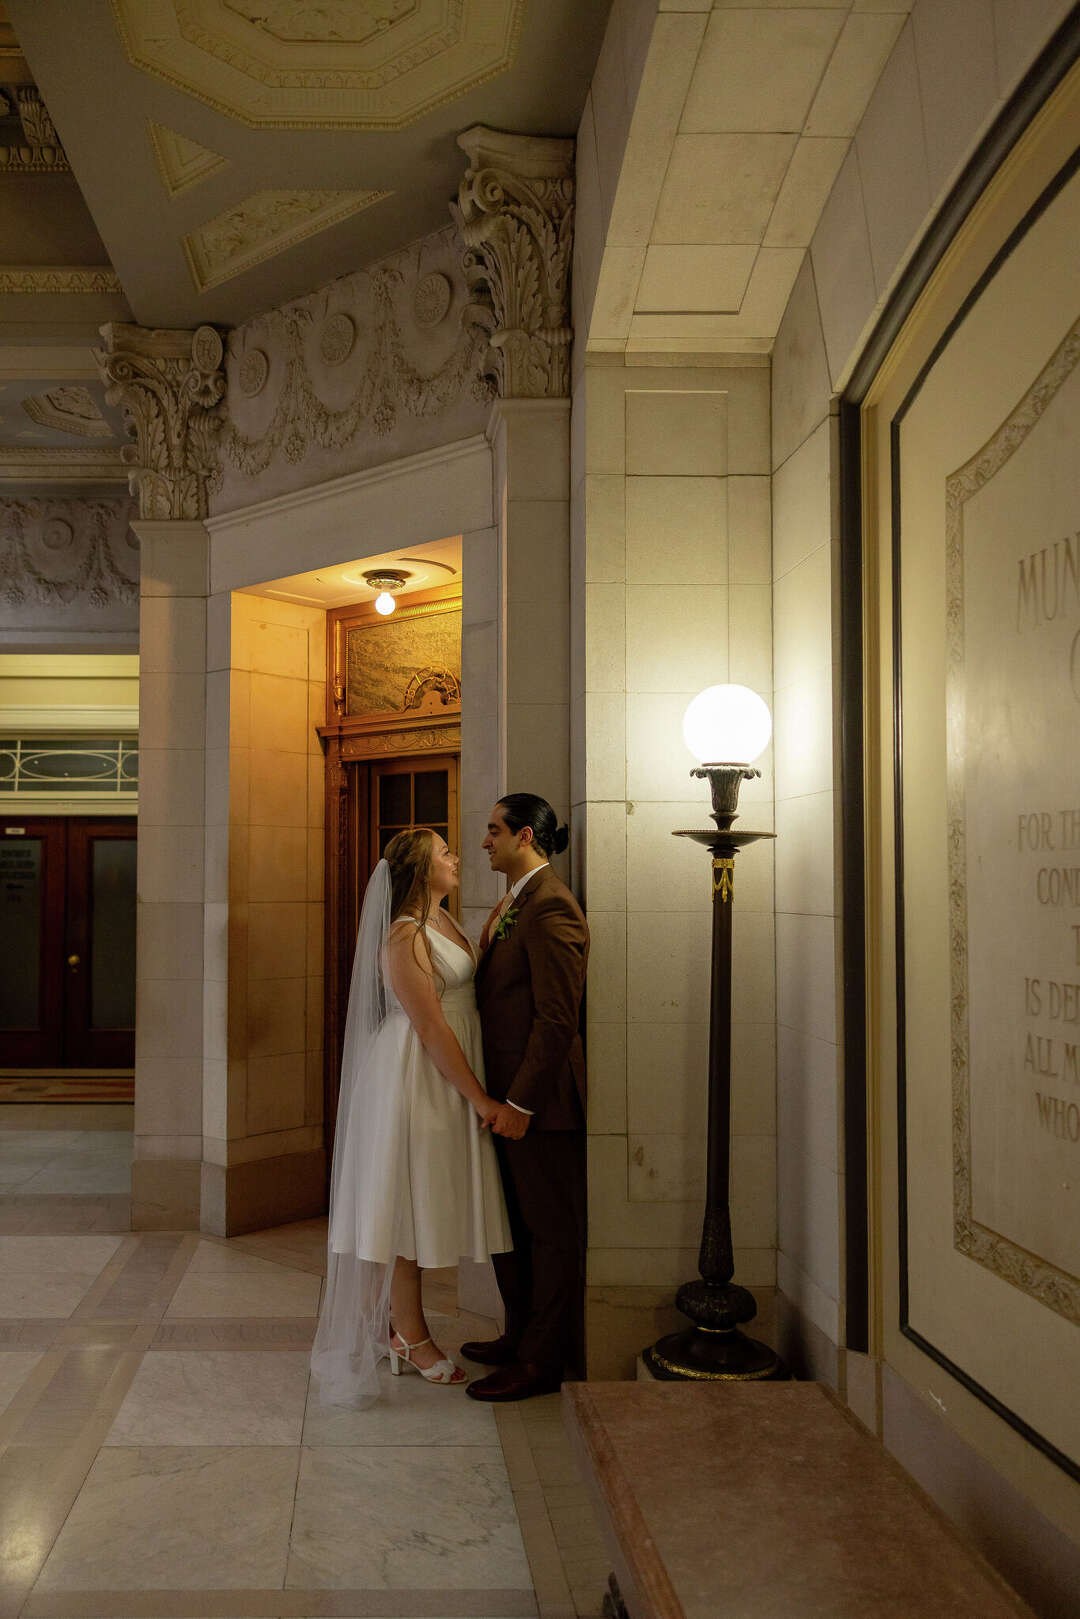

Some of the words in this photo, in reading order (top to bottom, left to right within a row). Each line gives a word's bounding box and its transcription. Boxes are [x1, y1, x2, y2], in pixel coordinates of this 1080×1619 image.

[1018, 812, 1055, 852] FOR
[1024, 976, 1041, 1017] IS
[1023, 1031, 1058, 1077] ALL
[1035, 1091, 1080, 1143] WHO
